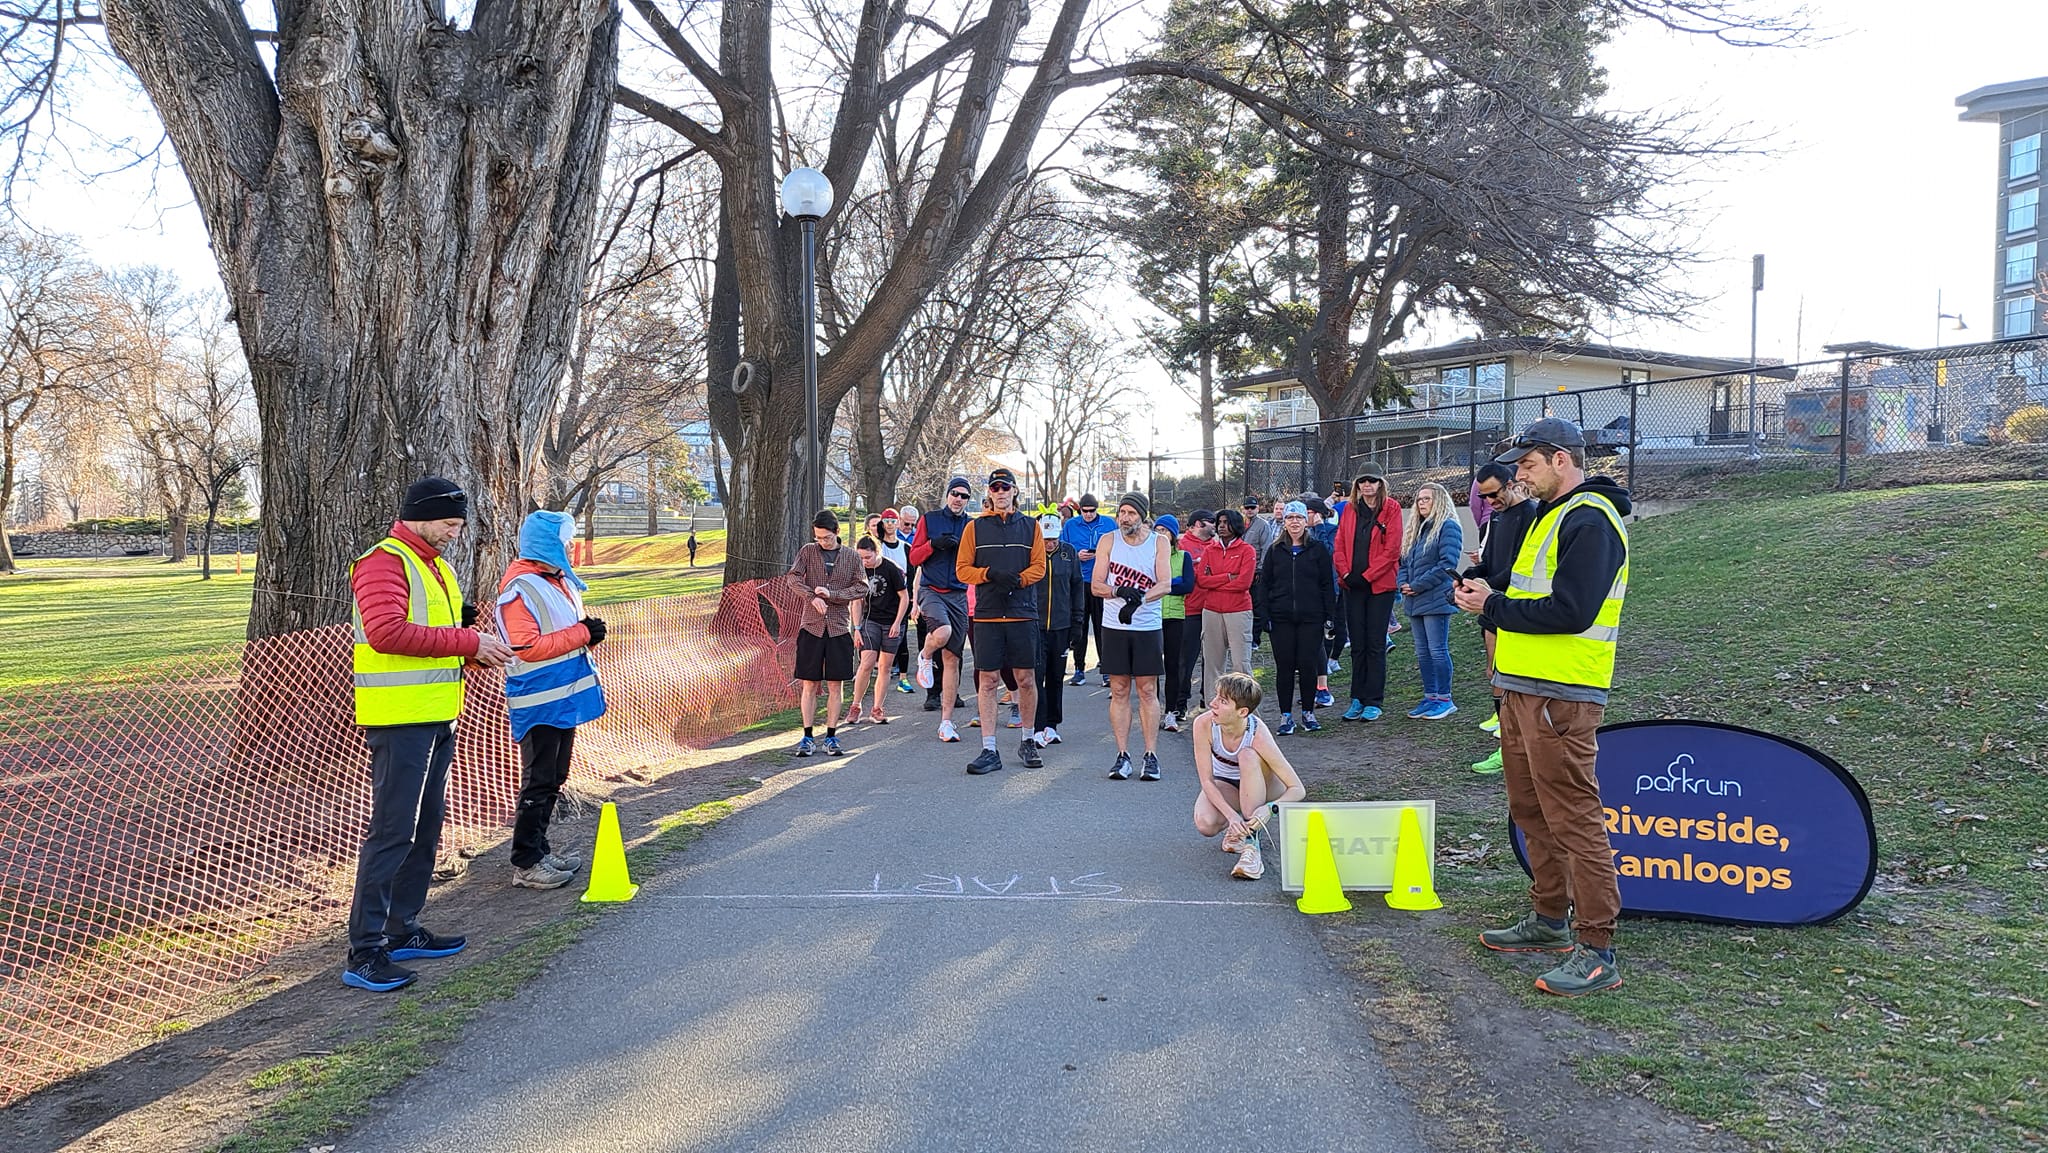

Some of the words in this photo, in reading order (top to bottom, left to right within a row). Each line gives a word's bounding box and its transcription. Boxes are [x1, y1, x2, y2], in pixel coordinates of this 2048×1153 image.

[1635, 755, 1742, 797] parkrun
[1603, 805, 1790, 852] Riverside,
[832, 871, 1122, 897] START
